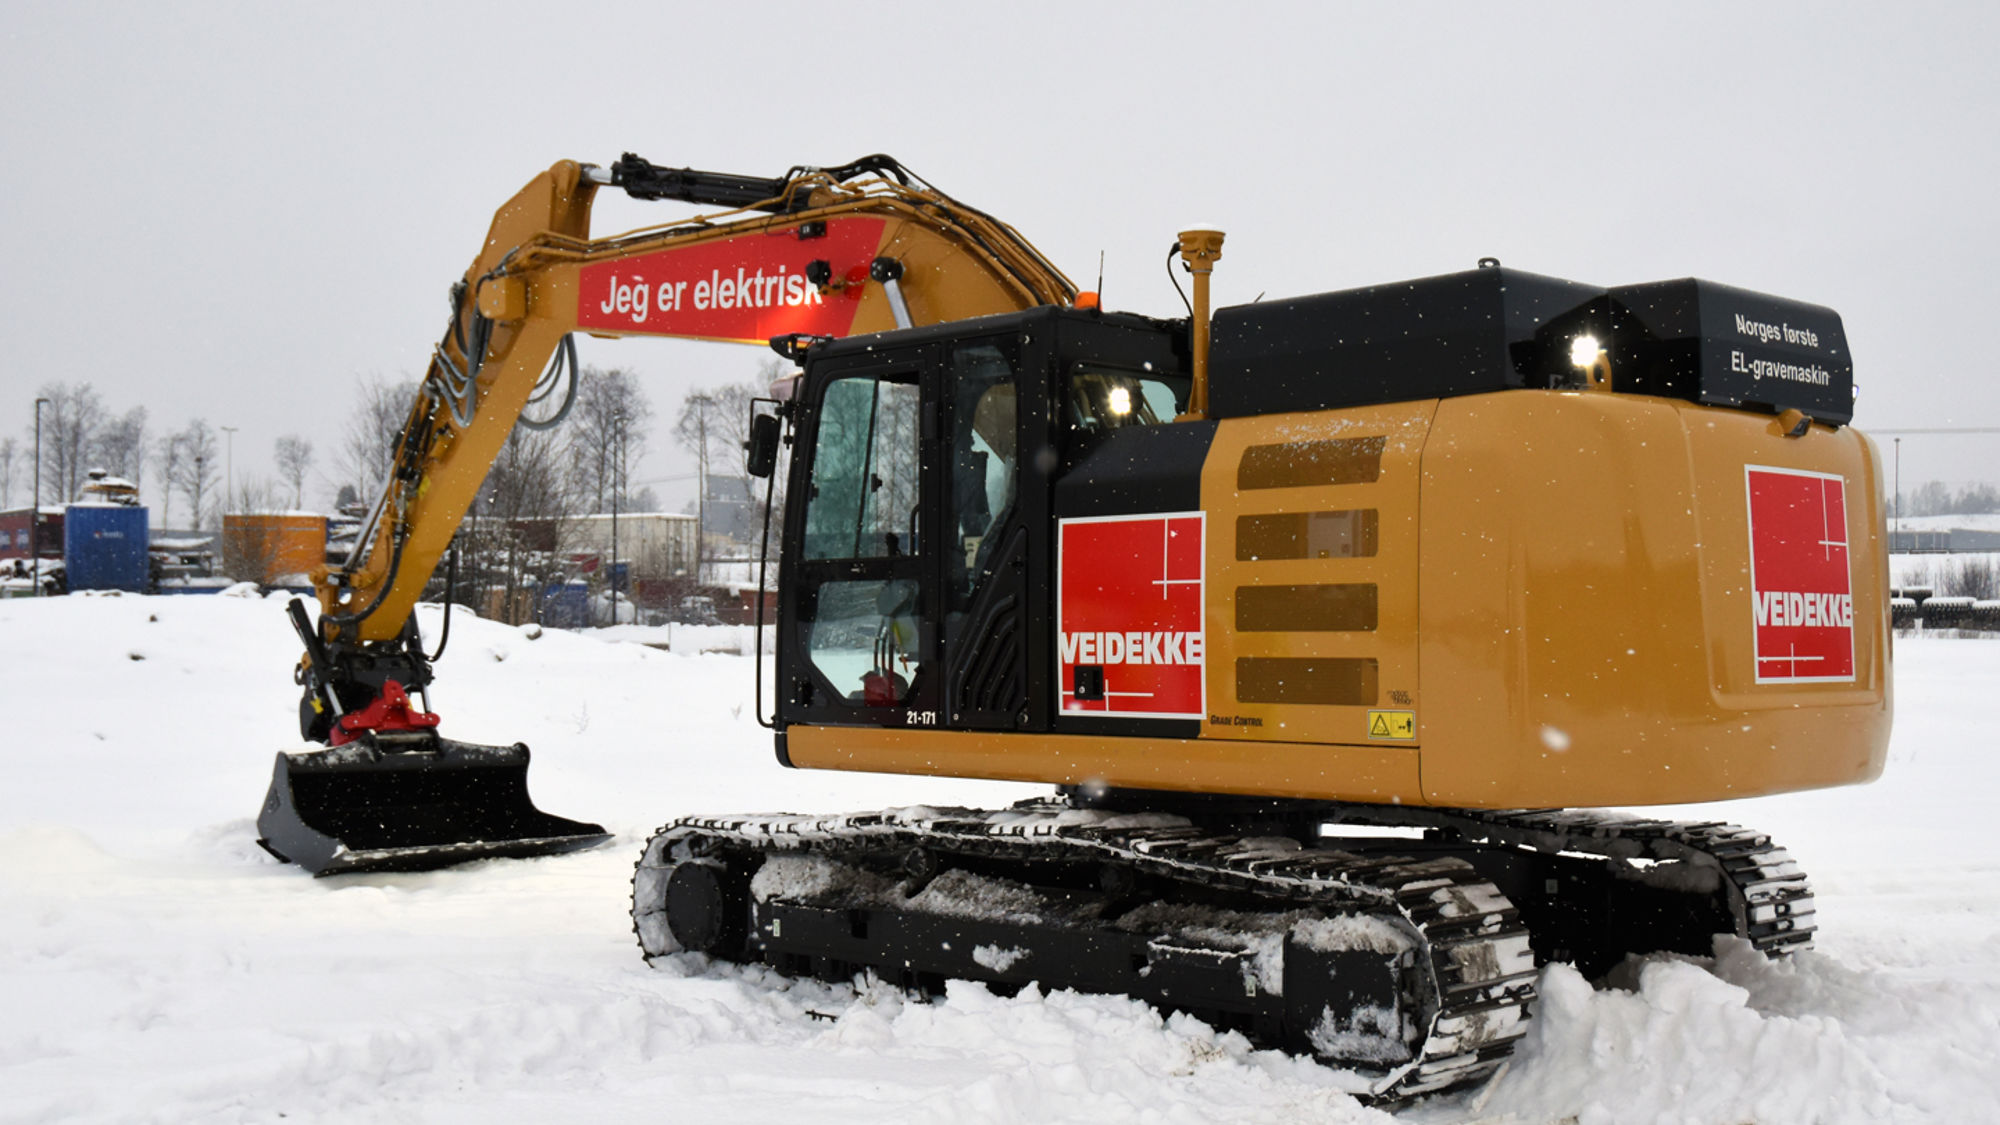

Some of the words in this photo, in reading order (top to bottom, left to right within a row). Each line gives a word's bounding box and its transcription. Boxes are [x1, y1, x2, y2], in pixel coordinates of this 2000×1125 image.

[601, 276, 649, 323] Jeg
[657, 280, 687, 312] er
[1735, 313, 1781, 343] Norges
[1783, 323, 1819, 347] første
[1731, 350, 1829, 386] EL-gravemaskin
[1752, 591, 1852, 627] VEIDEKKE
[1060, 631, 1202, 665] VEIDEKKE
[906, 710, 936, 725] 21-171
